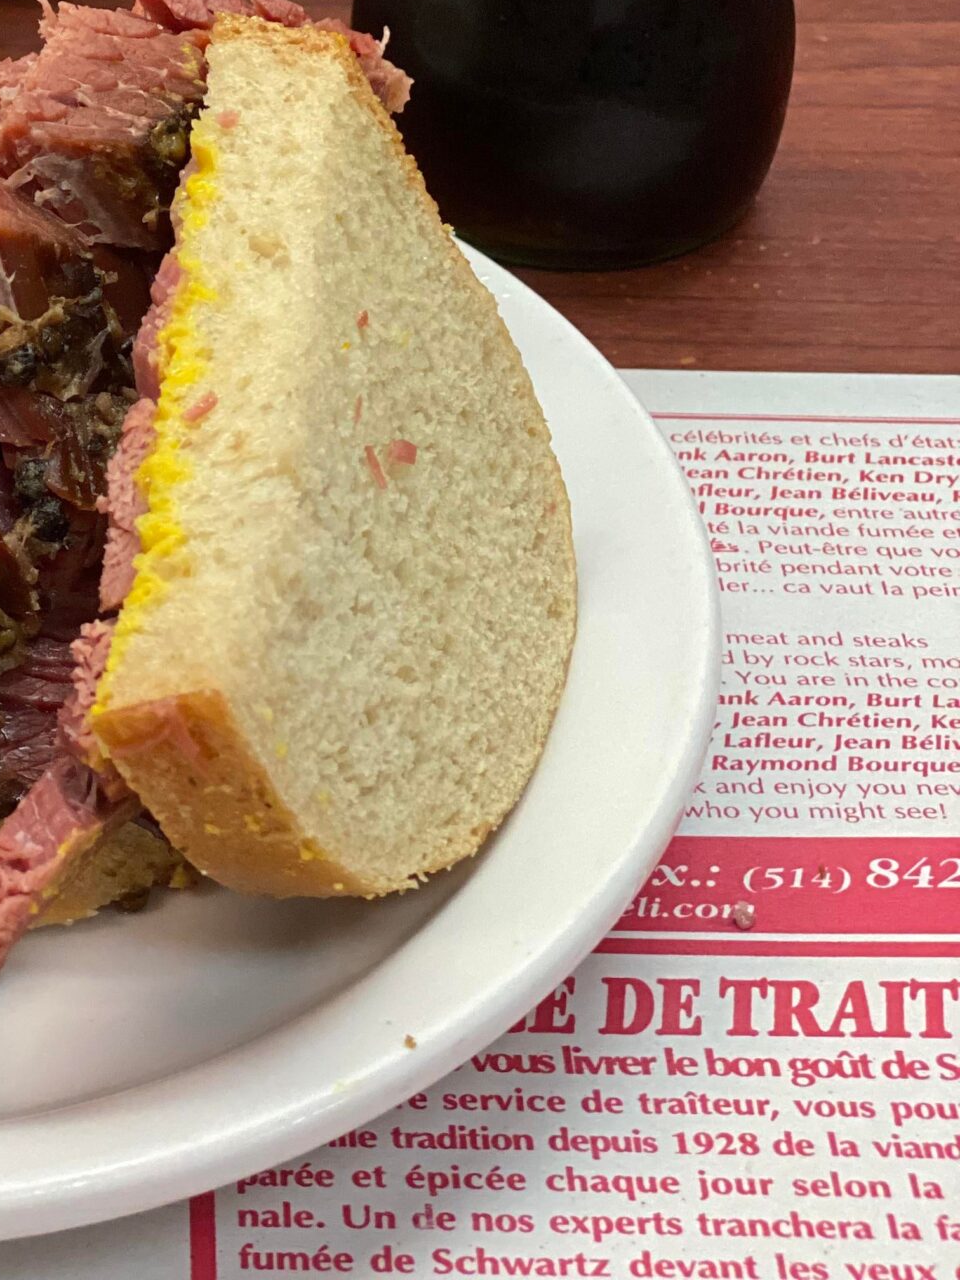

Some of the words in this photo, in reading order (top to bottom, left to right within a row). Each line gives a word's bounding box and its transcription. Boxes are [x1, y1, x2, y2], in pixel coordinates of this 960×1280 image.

[670, 430, 783, 445] célébrités
[790, 434, 811, 446] et
[819, 432, 881, 448] chefs
[674, 447, 707, 462] nk
[714, 449, 795, 466] Aaron,
[805, 451, 856, 465] Burt
[681, 466, 730, 480] ean
[737, 467, 849, 485] Chrétien,
[859, 470, 904, 484] Ken
[770, 485, 822, 500] Jean
[832, 487, 943, 506] Béliveau,
[715, 502, 825, 521] Bourque,
[833, 506, 894, 520] entre
[738, 521, 760, 535] la
[767, 523, 850, 538] viande
[857, 524, 934, 539] fumée
[758, 540, 868, 556] Peut-être
[876, 545, 923, 559] que
[781, 561, 880, 577] pendant
[889, 564, 953, 577] votre
[783, 582, 812, 594] ca
[819, 581, 872, 595] vaut
[881, 580, 904, 595] la
[726, 632, 790, 645] meat
[797, 631, 844, 646] and
[852, 632, 929, 648] steaks
[743, 650, 775, 668] by
[784, 651, 840, 667] rock
[848, 654, 913, 670] stars,
[735, 671, 787, 685] You
[796, 675, 837, 687] are
[844, 672, 869, 687] in
[877, 673, 919, 688] the
[767, 692, 857, 710] Aaron,
[866, 693, 922, 708] Burt
[731, 712, 788, 729] Jean
[797, 712, 921, 732] Chrétien,
[724, 733, 824, 752] Lafleur,
[834, 734, 891, 751] Jean
[711, 754, 838, 776] Raymond
[716, 777, 765, 795] and
[774, 778, 847, 799] enjoy
[856, 783, 907, 799] you
[685, 801, 740, 819] who
[748, 805, 799, 823] you
[809, 802, 887, 823] might
[894, 803, 948, 820] see!
[743, 867, 851, 894] (514)
[866, 856, 960, 889] 842
[598, 976, 702, 1037] DE
[719, 976, 960, 1039] TRAIT
[471, 1052, 556, 1074] vous
[561, 1045, 657, 1076] livrer
[663, 1047, 699, 1077] le
[704, 1047, 782, 1078] bon
[787, 1049, 877, 1088] goût
[881, 1050, 930, 1081] de
[442, 1087, 567, 1113] service
[581, 1089, 624, 1114] de
[638, 1090, 780, 1121] traîteur,
[793, 1098, 877, 1118] vous
[890, 1100, 960, 1127] pou
[390, 1124, 535, 1151] tradition
[547, 1126, 659, 1160] depuis
[671, 1131, 761, 1156] 1928
[772, 1130, 815, 1157] de
[826, 1131, 861, 1158] la
[237, 1162, 334, 1194] parée
[352, 1166, 388, 1188] et
[405, 1164, 527, 1197] épicée
[545, 1166, 681, 1201] chaque
[697, 1169, 774, 1201] jour
[792, 1171, 892, 1199] selon
[907, 1172, 945, 1200] la
[237, 1201, 326, 1229] nale.
[342, 1204, 396, 1230] Un
[411, 1203, 456, 1231] de
[471, 1211, 535, 1233] nos
[549, 1211, 683, 1243] experts
[696, 1211, 875, 1240] tranchera
[885, 1213, 923, 1241] la
[238, 1243, 354, 1271] fumée
[369, 1245, 415, 1273] de
[431, 1248, 611, 1278] Schwartz
[628, 1250, 761, 1280] devant
[774, 1253, 830, 1280] les
